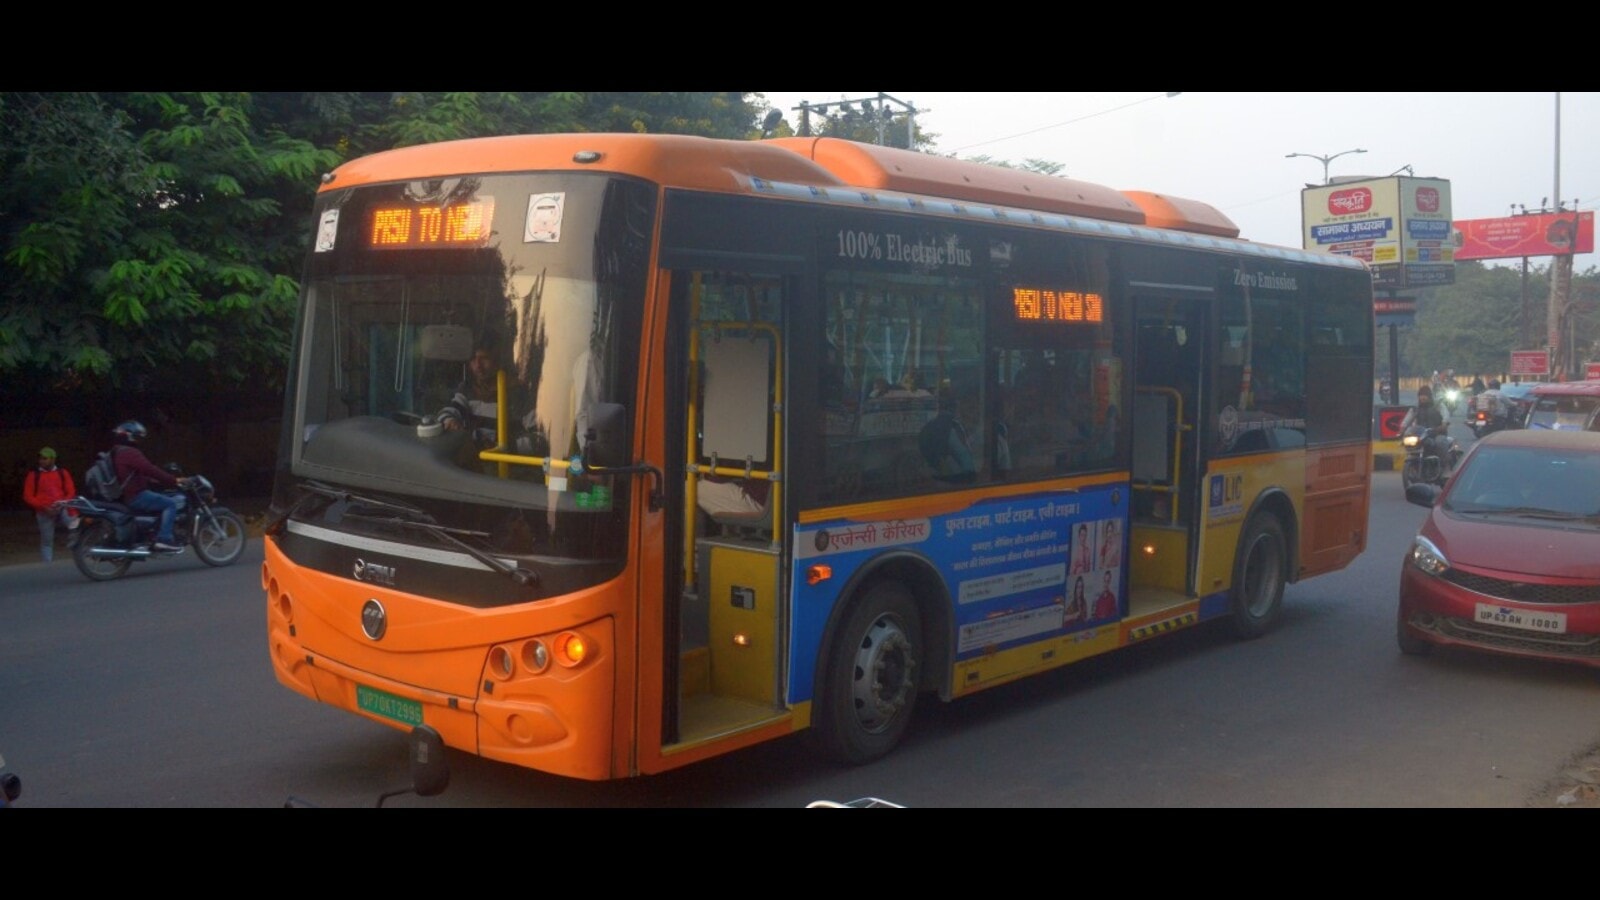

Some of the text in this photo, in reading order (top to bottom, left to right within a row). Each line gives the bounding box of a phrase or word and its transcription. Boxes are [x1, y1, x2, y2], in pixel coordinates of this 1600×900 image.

[419, 207, 441, 242] TO
[1317, 220, 1386, 236] सामान्य अध्ययन
[838, 229, 972, 267] 100% Electric Bus
[1233, 269, 1257, 287] Zero
[1225, 475, 1242, 501] LIC
[830, 525, 877, 549] एजेन्सी
[1480, 611, 1492, 620] UP
[1494, 613, 1506, 622] 63
